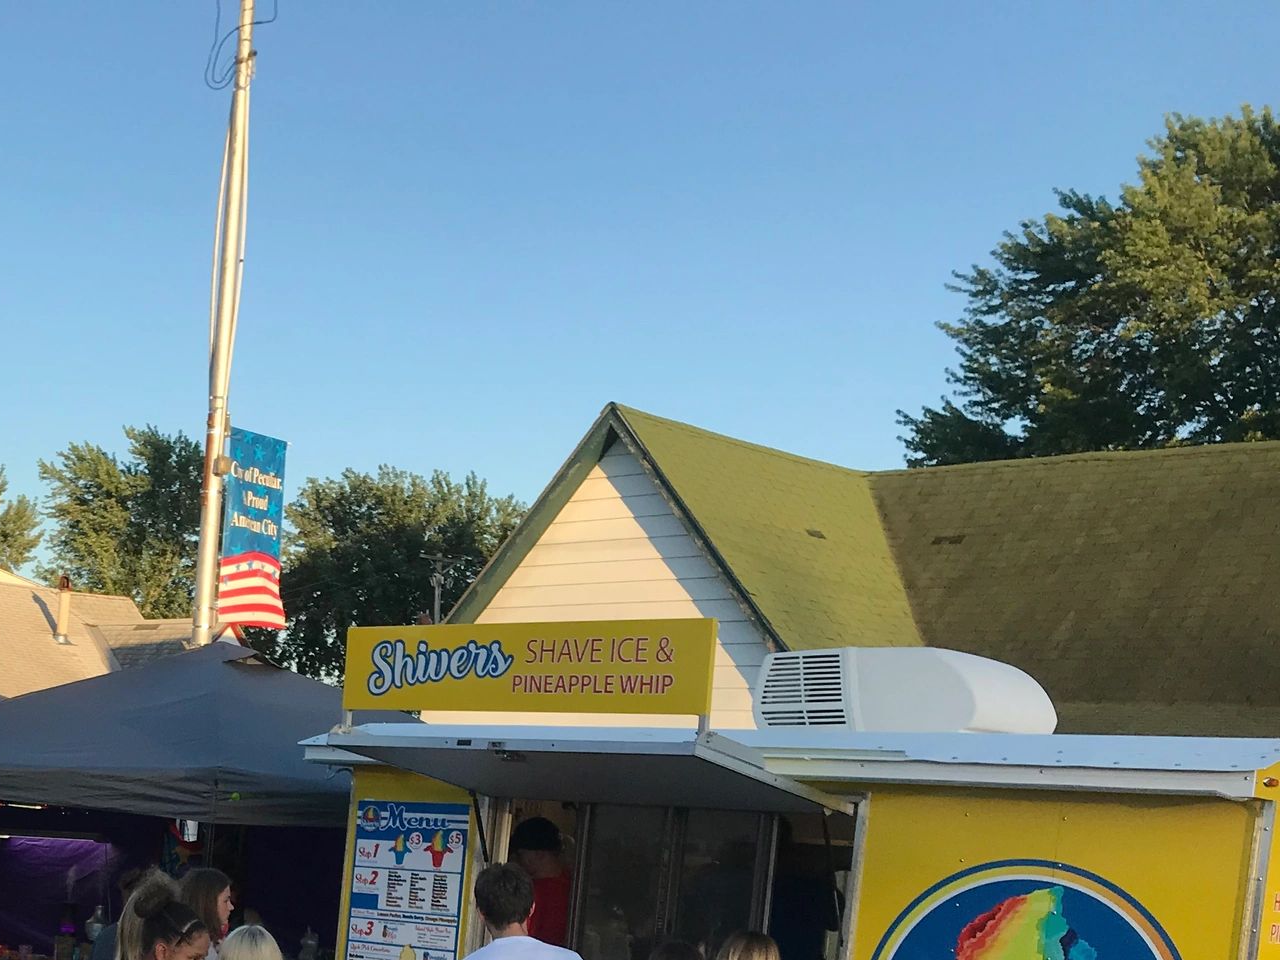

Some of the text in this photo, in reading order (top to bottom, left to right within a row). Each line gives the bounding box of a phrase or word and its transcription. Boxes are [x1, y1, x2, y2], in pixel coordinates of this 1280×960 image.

[244, 467, 253, 483] of
[247, 491, 268, 510] Proud
[262, 519, 278, 540] City
[525, 637, 675, 664] SHAVE ICE &
[368, 639, 513, 696] Shivers
[512, 674, 675, 695] PINEAPPLE WHIP
[379, 803, 452, 831] Menu
[409, 833, 422, 845] $3
[450, 832, 461, 845] $5
